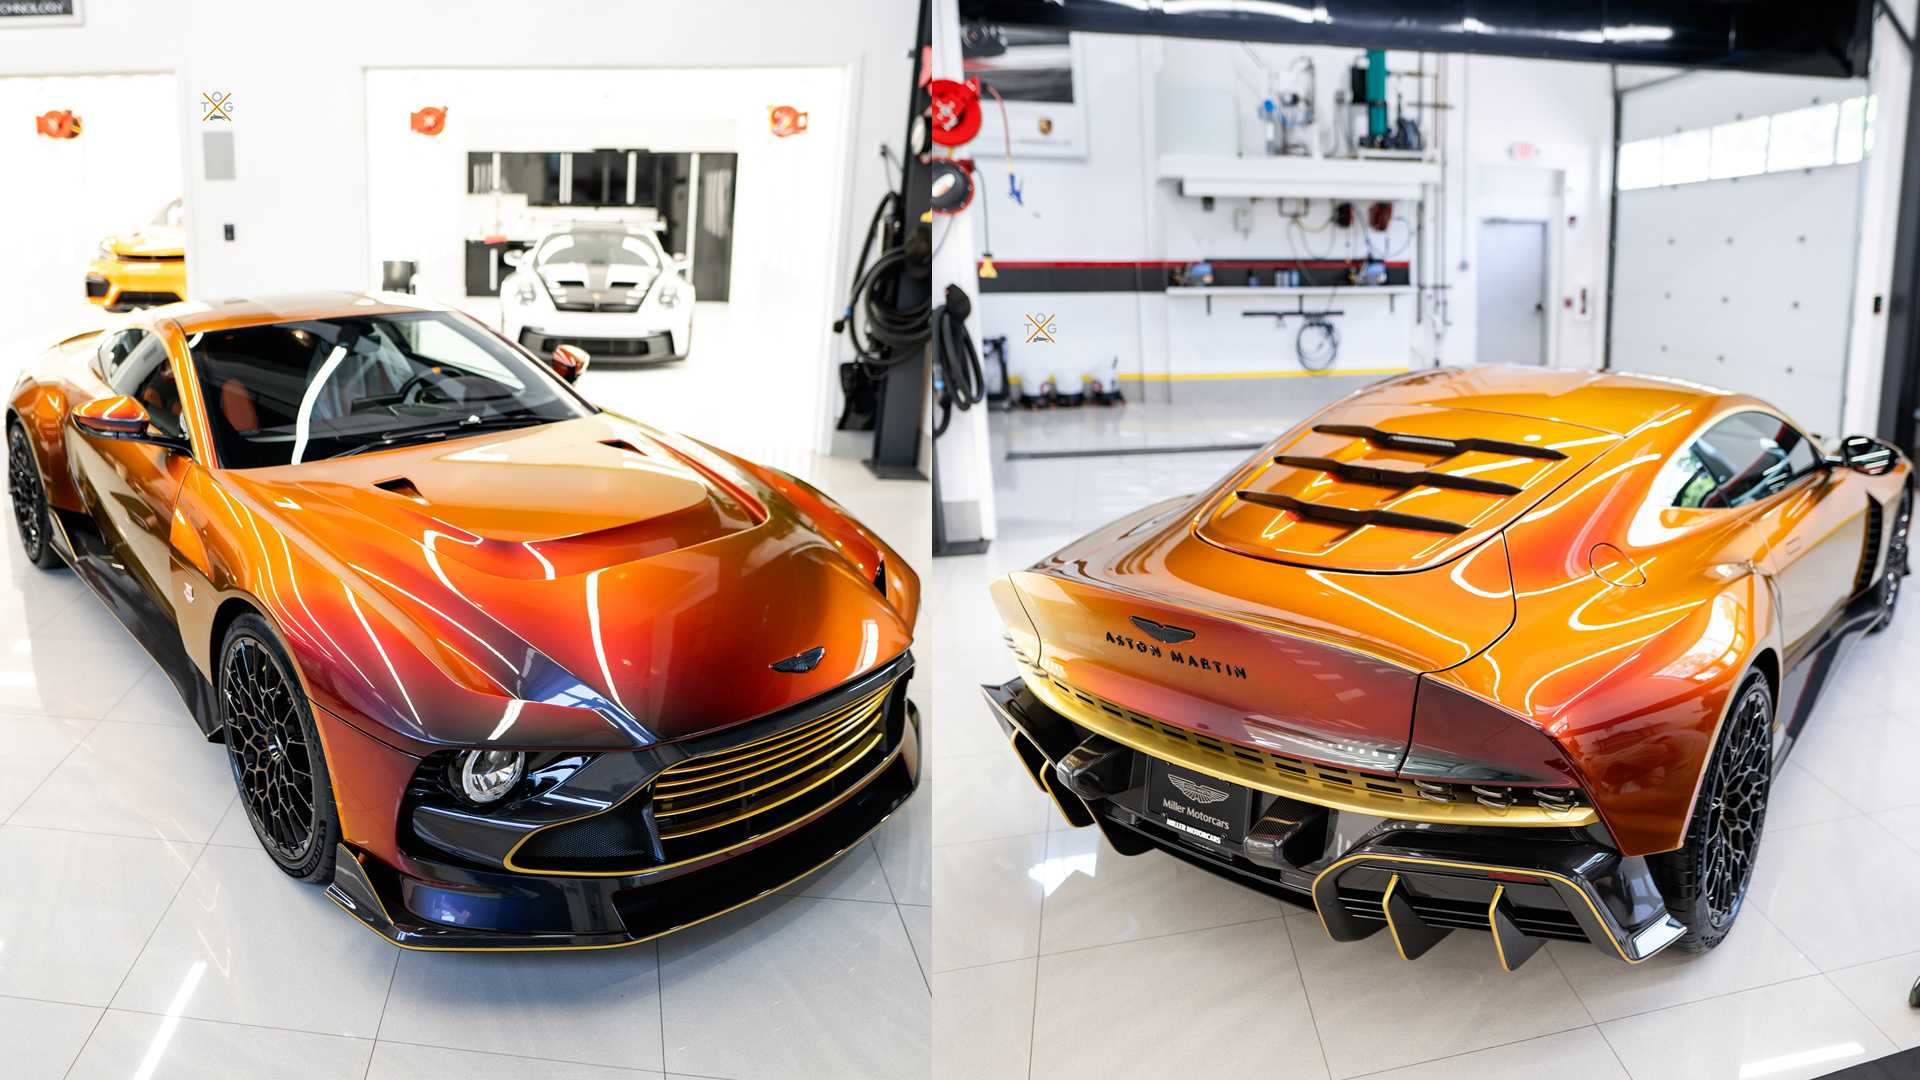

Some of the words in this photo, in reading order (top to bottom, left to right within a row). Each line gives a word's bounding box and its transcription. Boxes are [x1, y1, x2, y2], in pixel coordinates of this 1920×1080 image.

[1105, 631, 1162, 658] ASTON
[1170, 650, 1247, 680] MARTIN
[1162, 797, 1186, 813] Miller
[1186, 807, 1230, 830] Motorcars
[1166, 818, 1186, 831] MILLER
[1186, 825, 1221, 844] MOTORCARS
